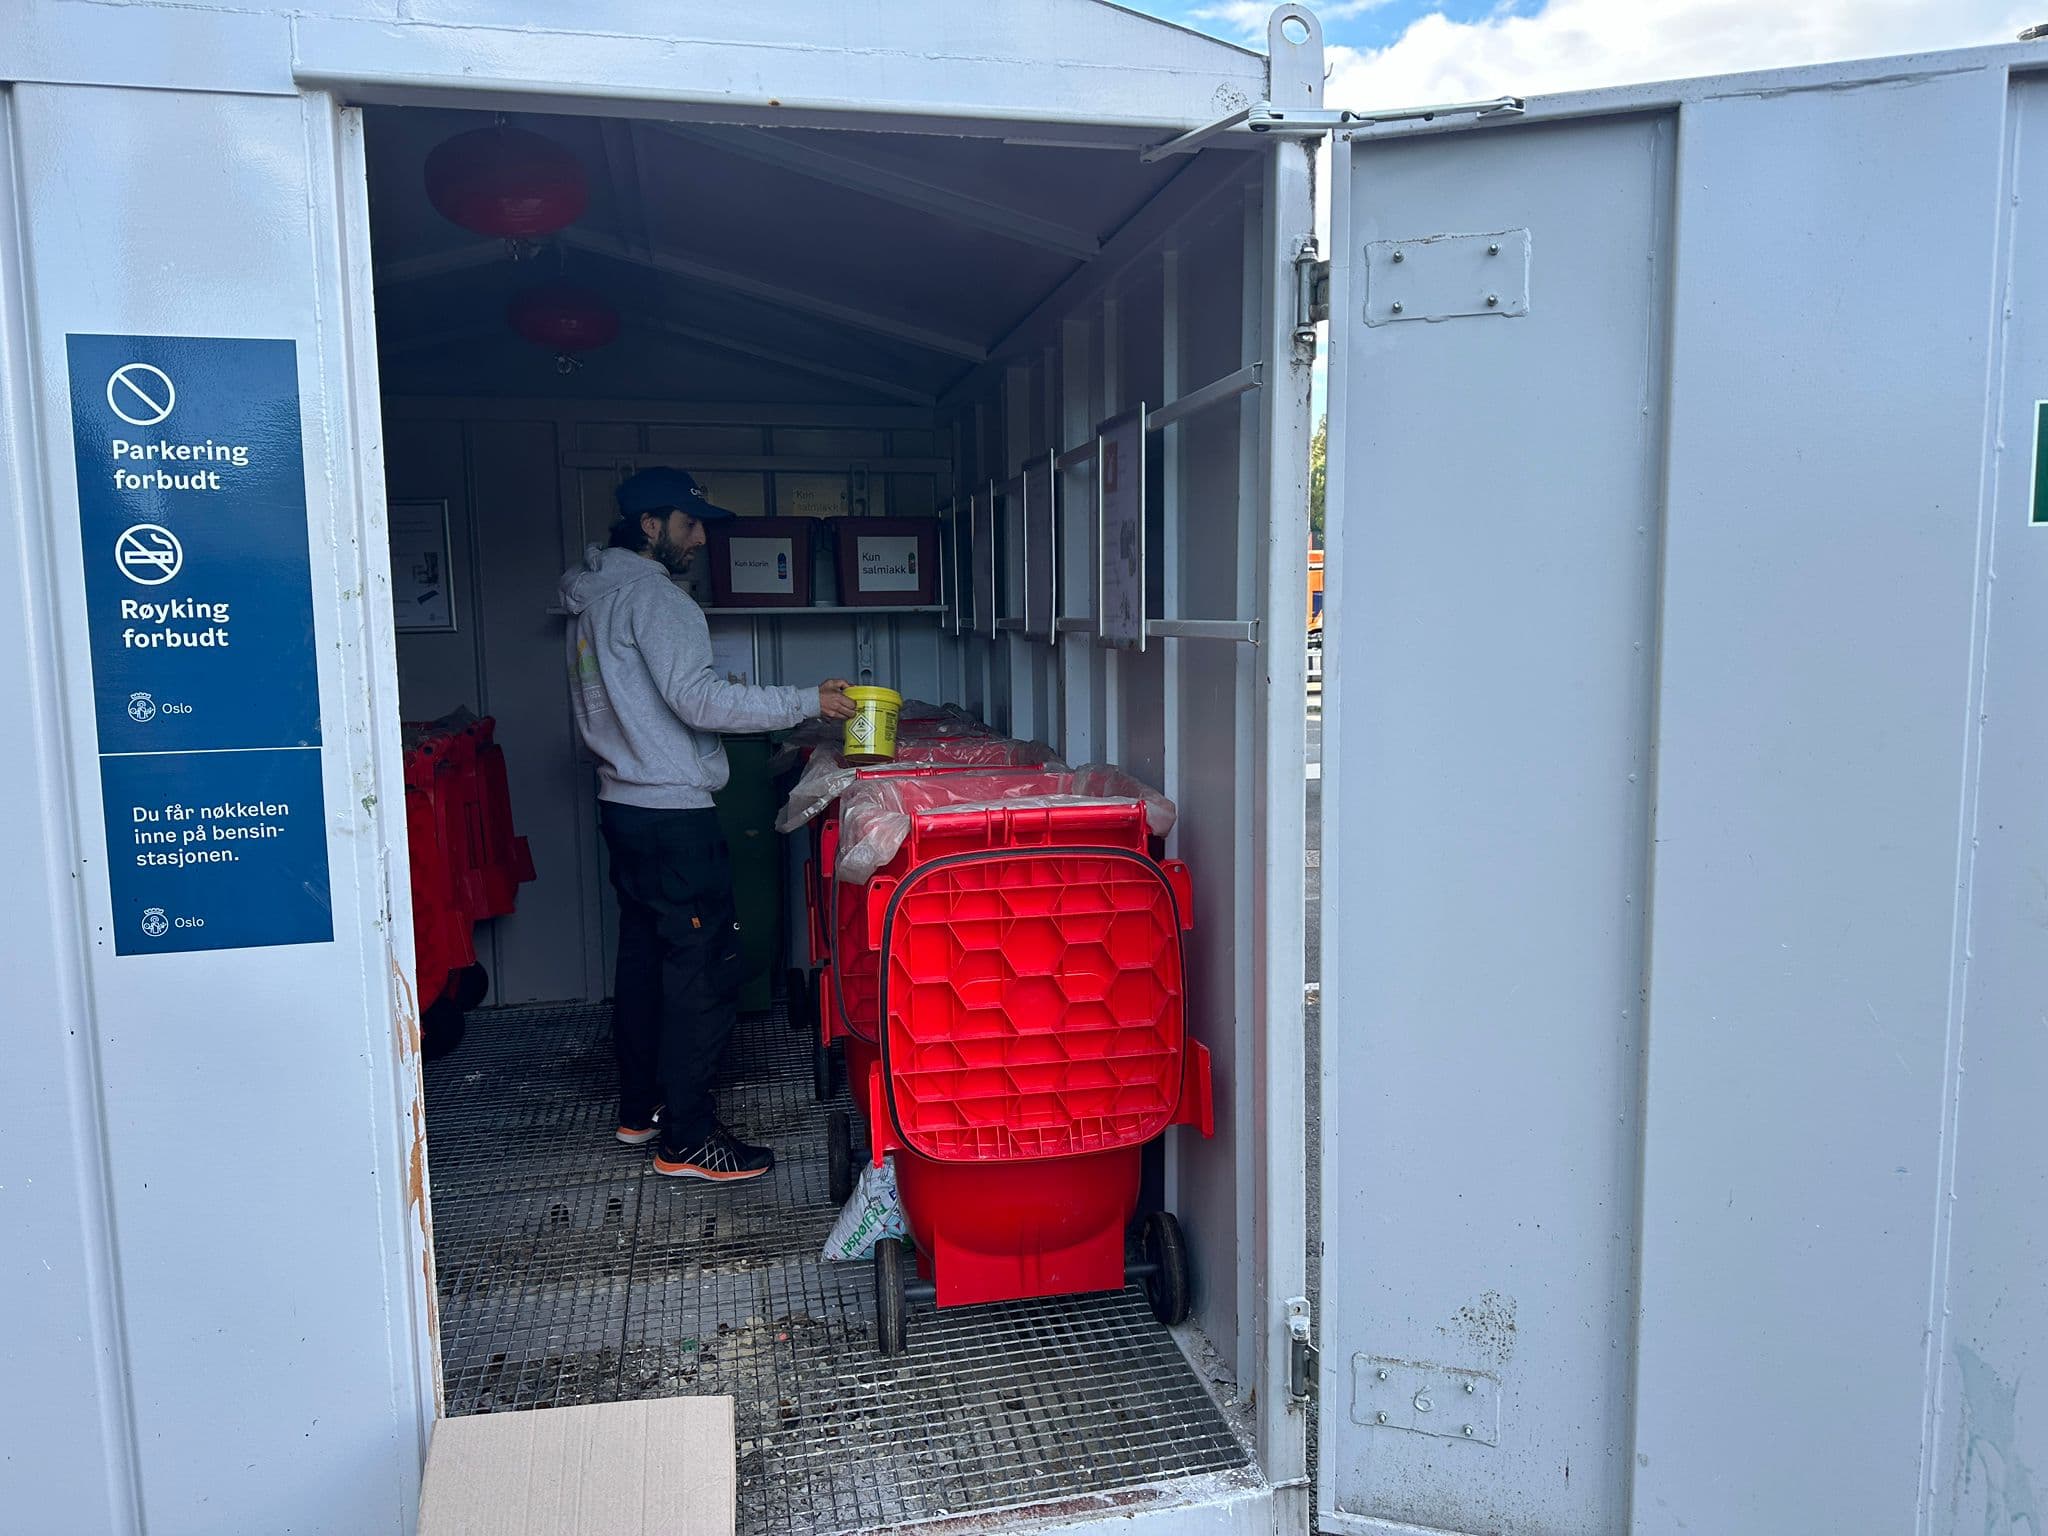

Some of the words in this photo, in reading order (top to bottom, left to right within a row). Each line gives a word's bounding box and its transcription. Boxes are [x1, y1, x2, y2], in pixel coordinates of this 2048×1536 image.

[112, 438, 249, 466] Parkering
[114, 469, 221, 490] forbudt
[749, 559, 769, 567] klorin
[862, 552, 880, 562] Kun
[862, 564, 906, 575] salmiakk
[121, 597, 230, 623] Røyking
[122, 628, 230, 648] forbudt
[162, 702, 192, 715] Oslo
[132, 806, 159, 823] Du
[165, 802, 194, 821] får
[200, 800, 289, 820] nøkkelen
[134, 827, 177, 844] inne
[182, 824, 207, 847] på
[212, 822, 285, 842] bensin-
[136, 847, 240, 868] stasjonen.
[174, 916, 204, 928] Oslo
